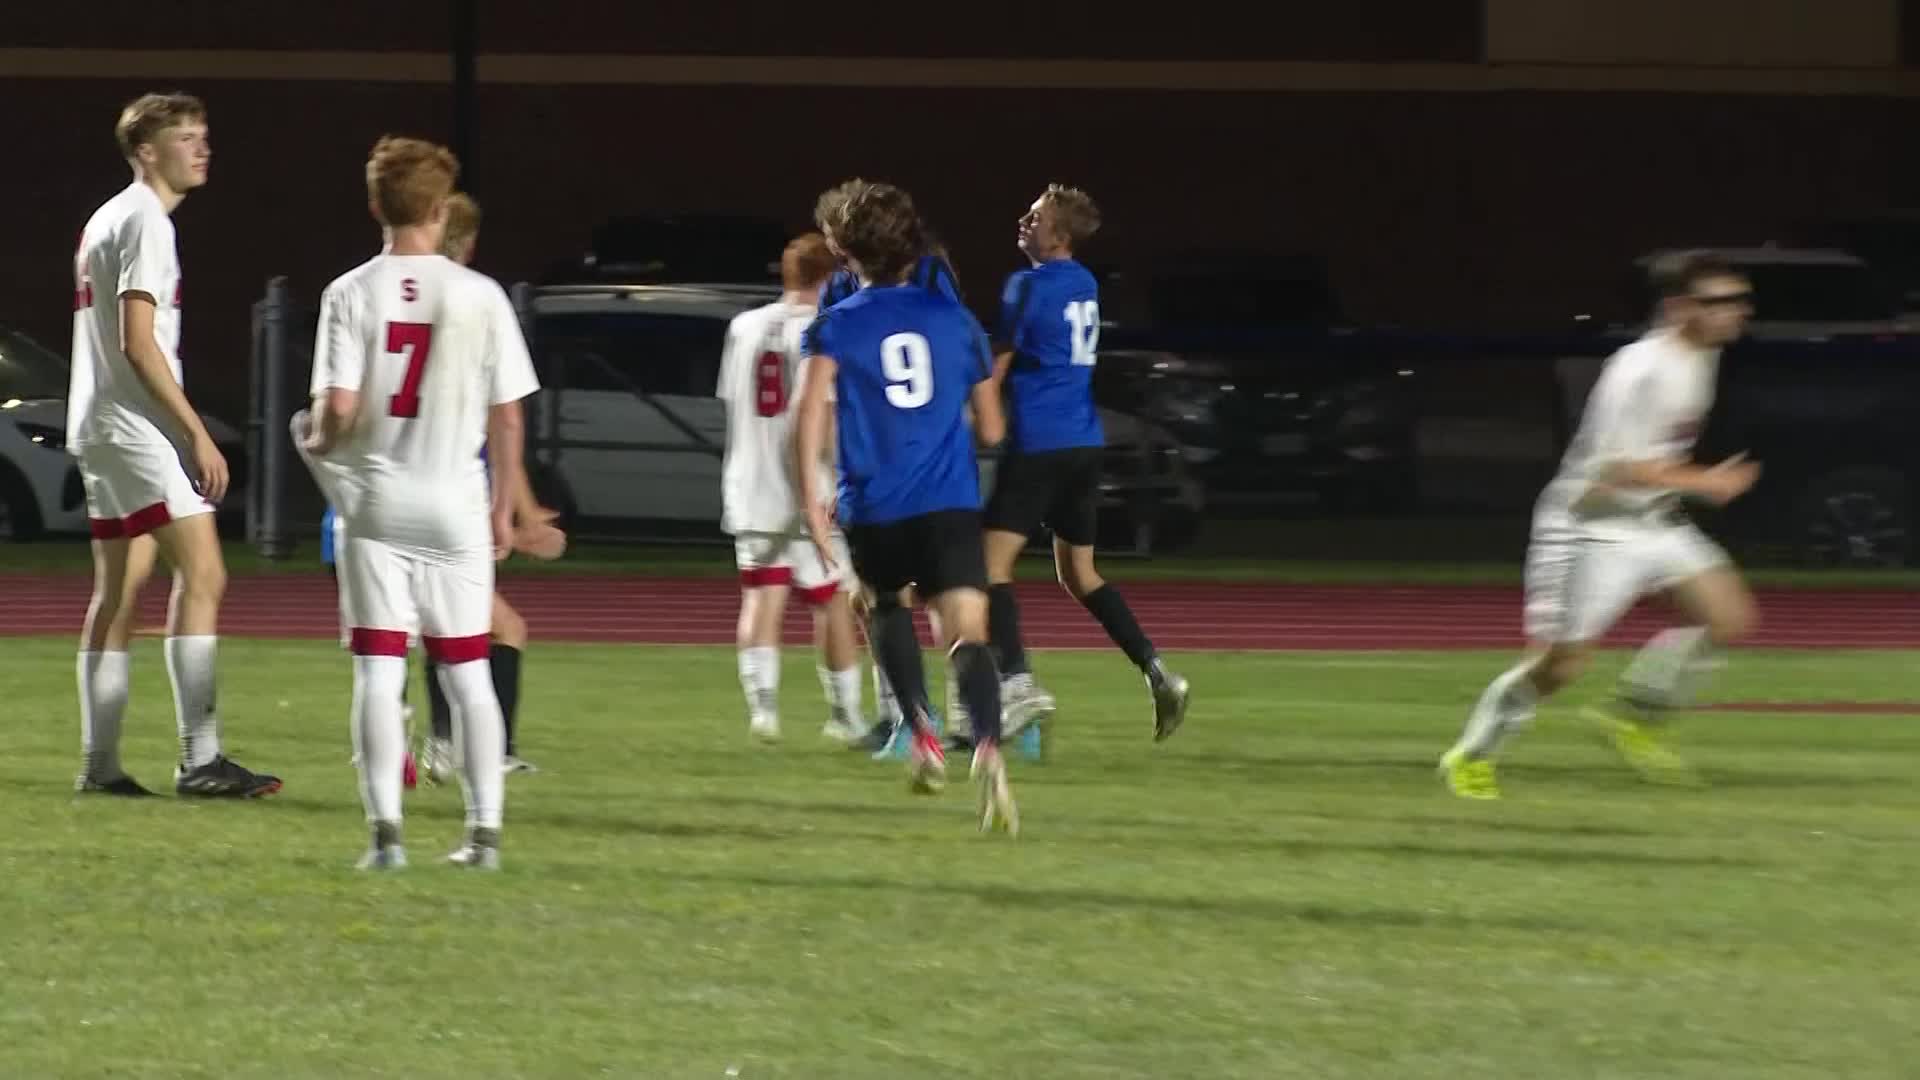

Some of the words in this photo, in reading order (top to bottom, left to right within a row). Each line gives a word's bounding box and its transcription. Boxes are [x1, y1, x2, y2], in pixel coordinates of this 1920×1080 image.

[400, 278, 419, 302] S
[1063, 300, 1101, 366] 12
[385, 320, 434, 418] 7
[756, 351, 787, 417] 8
[880, 331, 935, 409] 9
